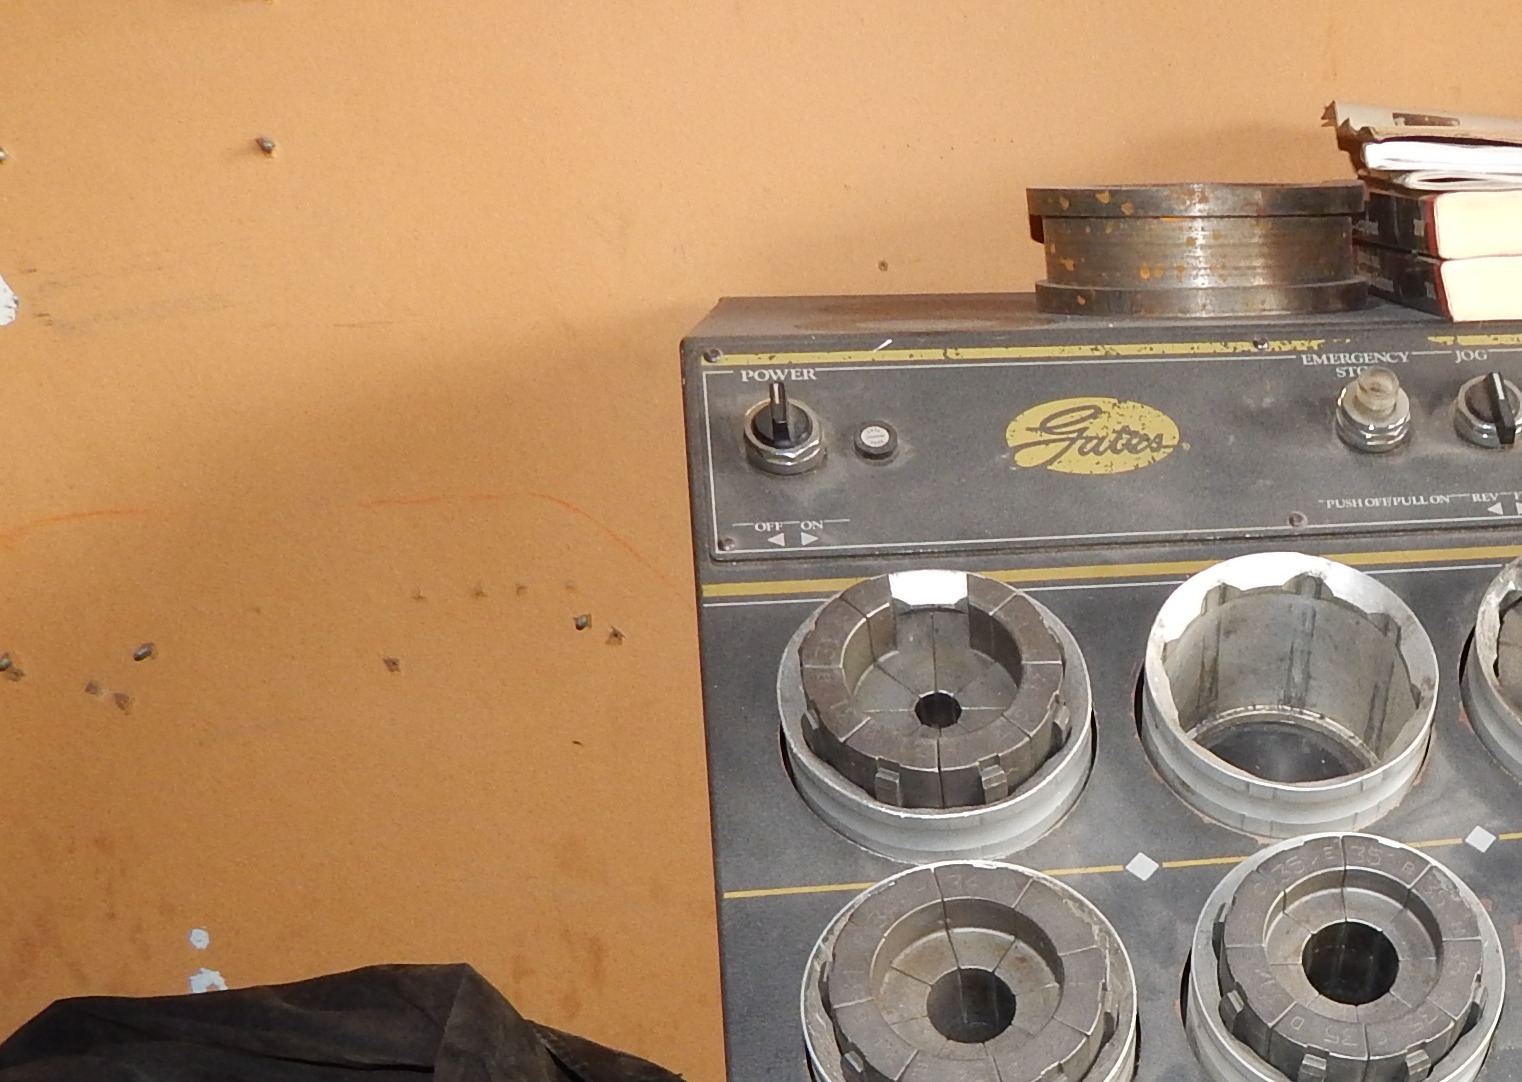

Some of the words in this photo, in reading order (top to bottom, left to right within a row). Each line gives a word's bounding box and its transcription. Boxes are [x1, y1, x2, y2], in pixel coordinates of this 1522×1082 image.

[1301, 351, 1410, 366] EMERGENCY
[1455, 350, 1488, 363] JOG
[741, 368, 817, 382] POWER
[1009, 404, 1177, 468] Gates
[1326, 498, 1363, 509] PUSH
[1429, 494, 1451, 505] ON
[1472, 492, 1499, 503] REV
[754, 521, 784, 532] OFF
[800, 520, 823, 530] ON
